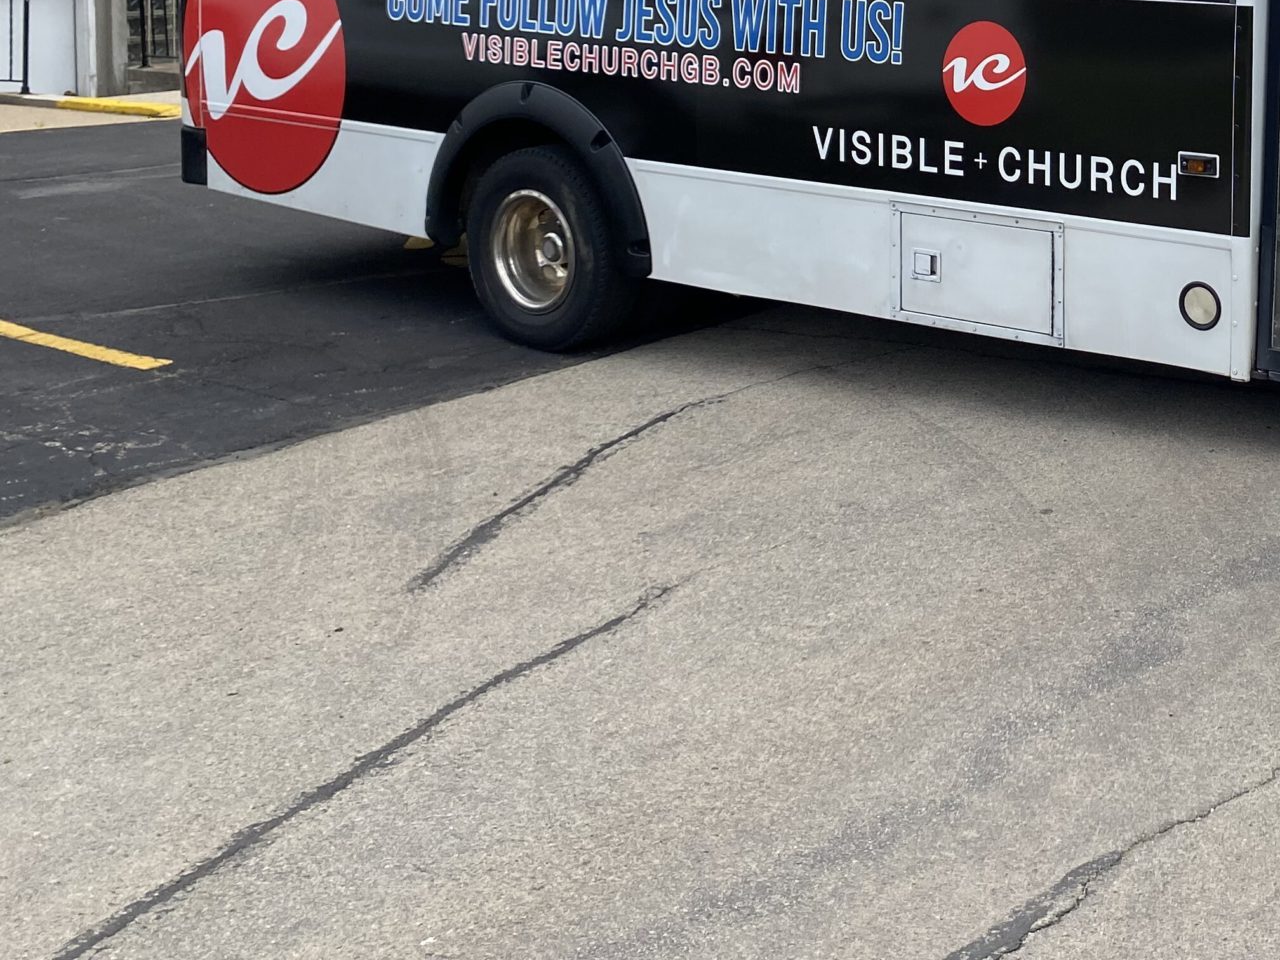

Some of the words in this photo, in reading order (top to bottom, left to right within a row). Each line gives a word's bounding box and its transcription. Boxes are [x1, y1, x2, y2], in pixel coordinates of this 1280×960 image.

[462, 32, 801, 93] VISIBLECHURCHGB.COM
[812, 125, 964, 177] VISIBLE
[998, 147, 1177, 201] CHURCH
